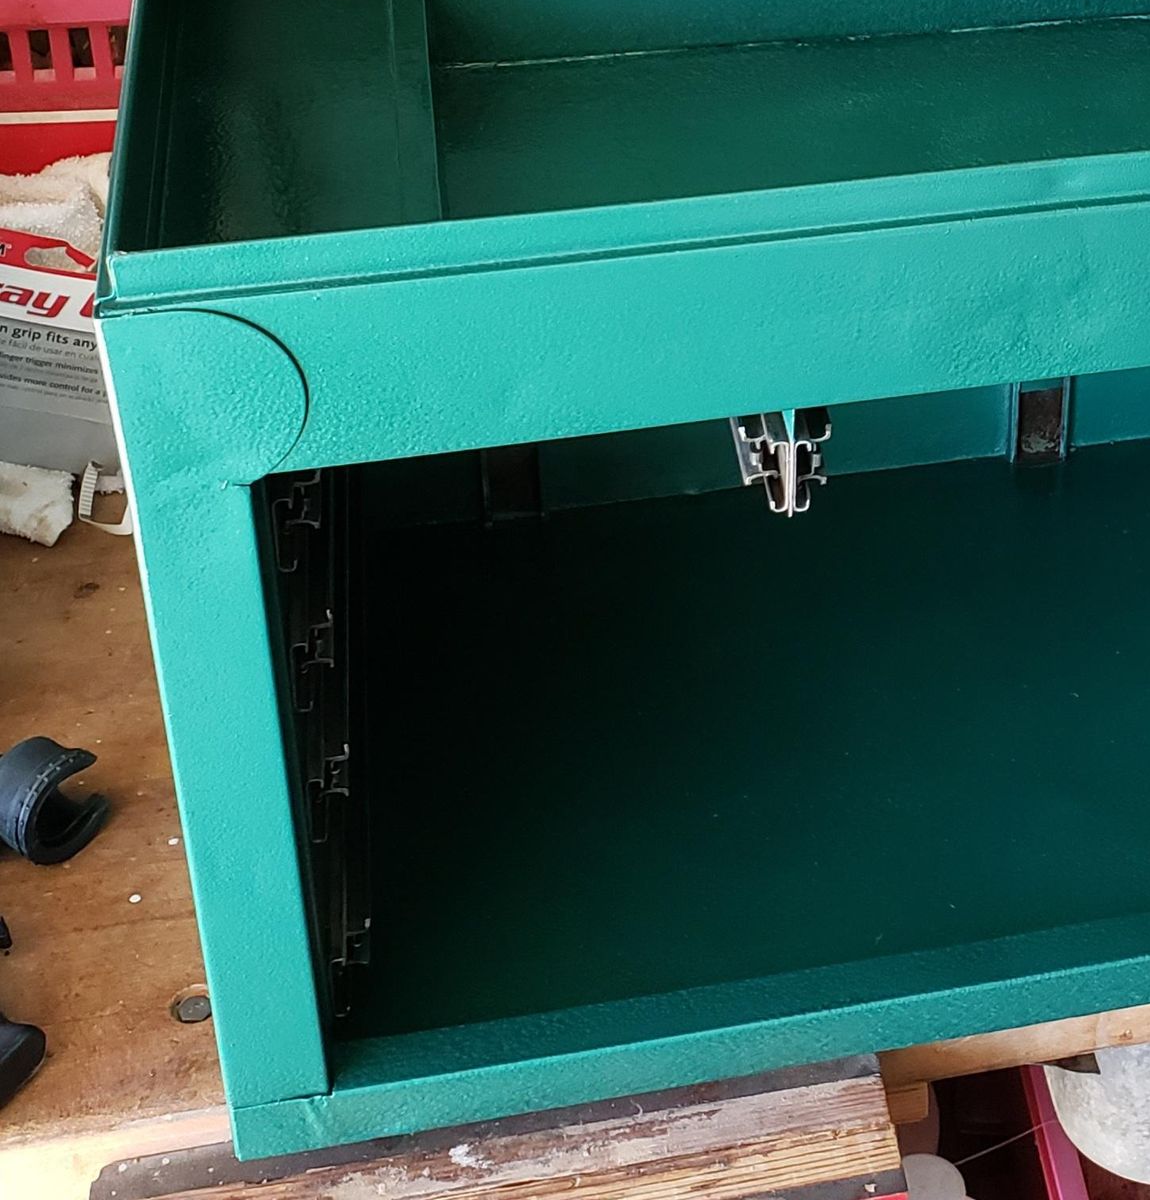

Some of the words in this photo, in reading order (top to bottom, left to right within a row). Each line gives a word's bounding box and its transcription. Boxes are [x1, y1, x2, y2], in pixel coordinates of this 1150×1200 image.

[11, 327, 42, 342] grip
[46, 331, 69, 345] fits
[73, 338, 98, 352] any
[29, 343, 42, 351] de
[25, 356, 53, 368] trigger
[23, 377, 48, 387] more
[49, 381, 80, 393] control
[80, 385, 94, 396] for
